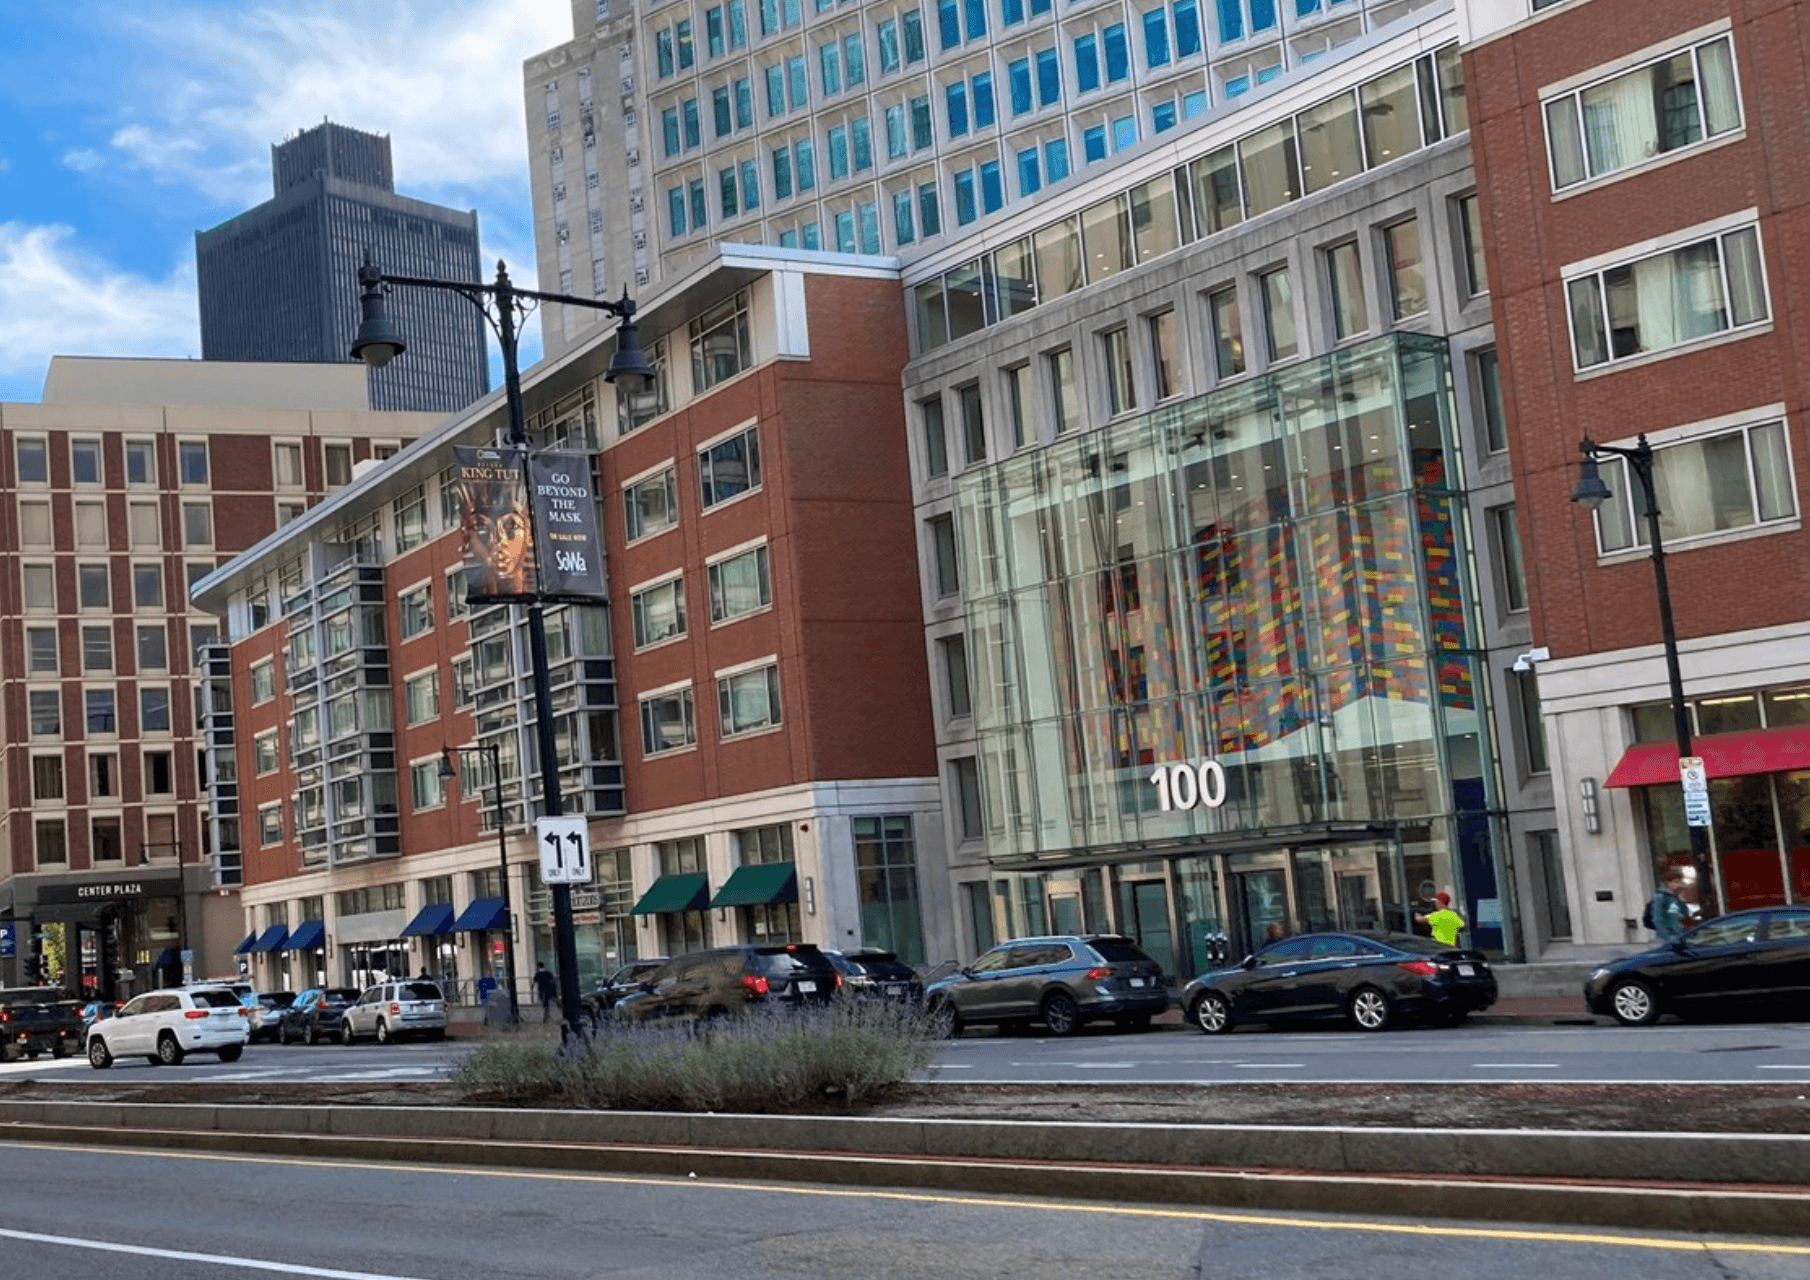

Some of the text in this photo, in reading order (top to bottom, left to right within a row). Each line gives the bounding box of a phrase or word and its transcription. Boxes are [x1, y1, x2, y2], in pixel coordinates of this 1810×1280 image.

[461, 467, 520, 480] KING TUT
[551, 473, 570, 484] GO
[537, 485, 587, 498] BEYOND
[551, 499, 576, 511] THE
[549, 511, 582, 523] MASK
[1150, 760, 1226, 811] 100
[77, 884, 142, 897] CENTER PLAZA
[240, 963, 247, 972] P
